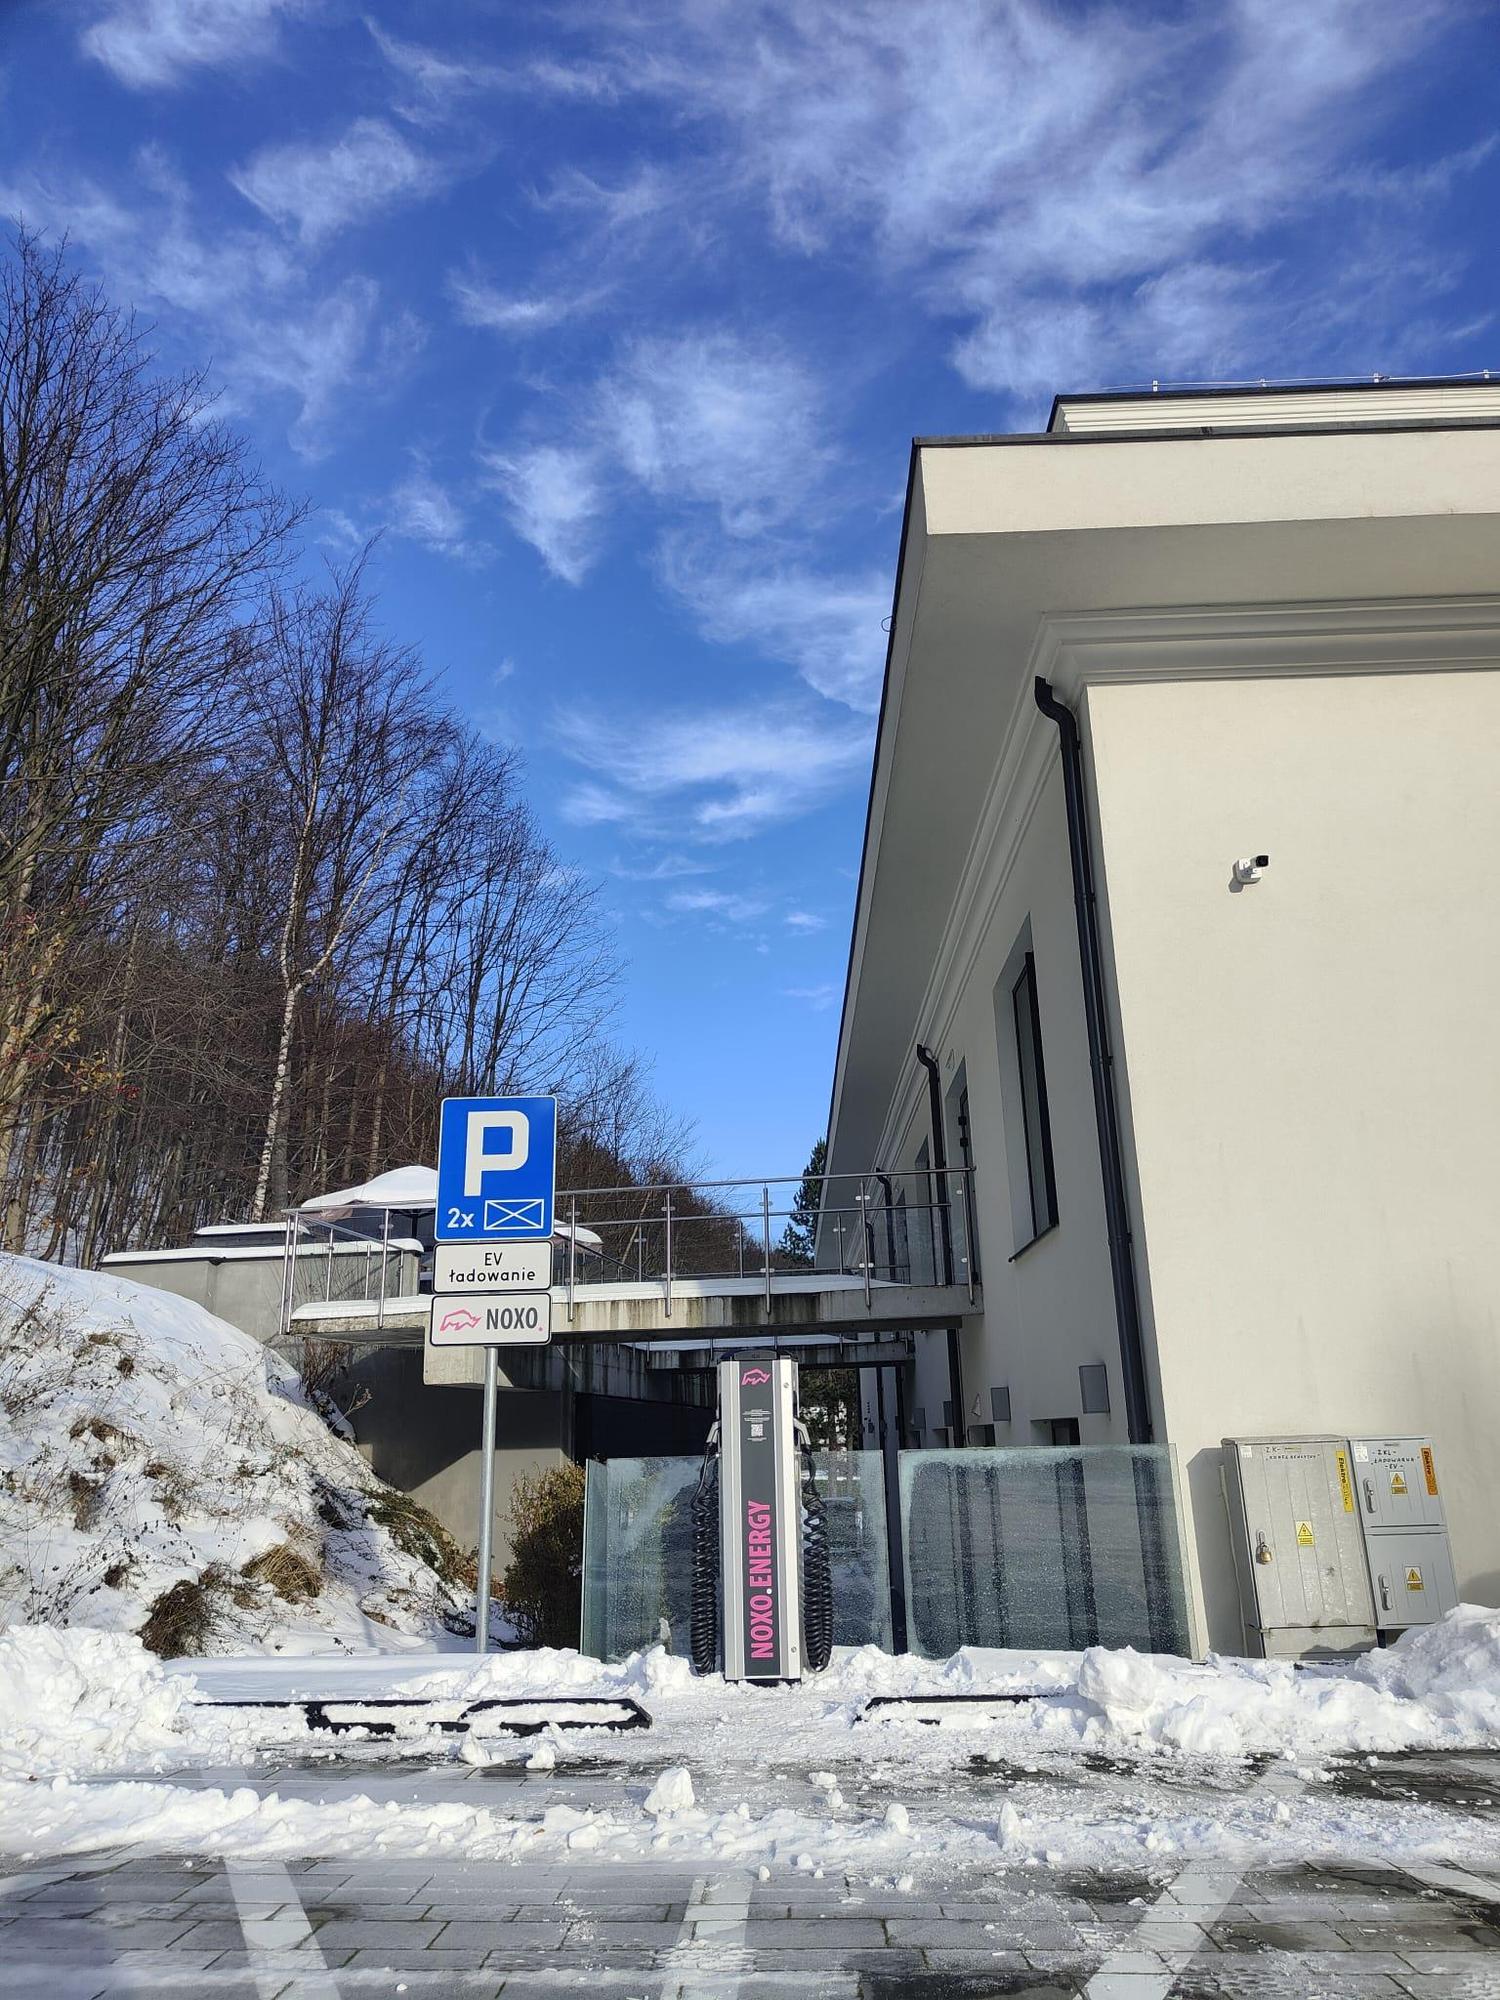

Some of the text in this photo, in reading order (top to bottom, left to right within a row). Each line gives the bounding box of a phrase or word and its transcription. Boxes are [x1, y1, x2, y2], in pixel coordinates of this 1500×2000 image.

[463, 1110, 530, 1197] P
[447, 1208, 474, 1229] 2x
[484, 1252, 503, 1267] EV
[449, 1267, 536, 1283] ładowanie
[748, 1500, 775, 1661] NOXO.ENERGY
